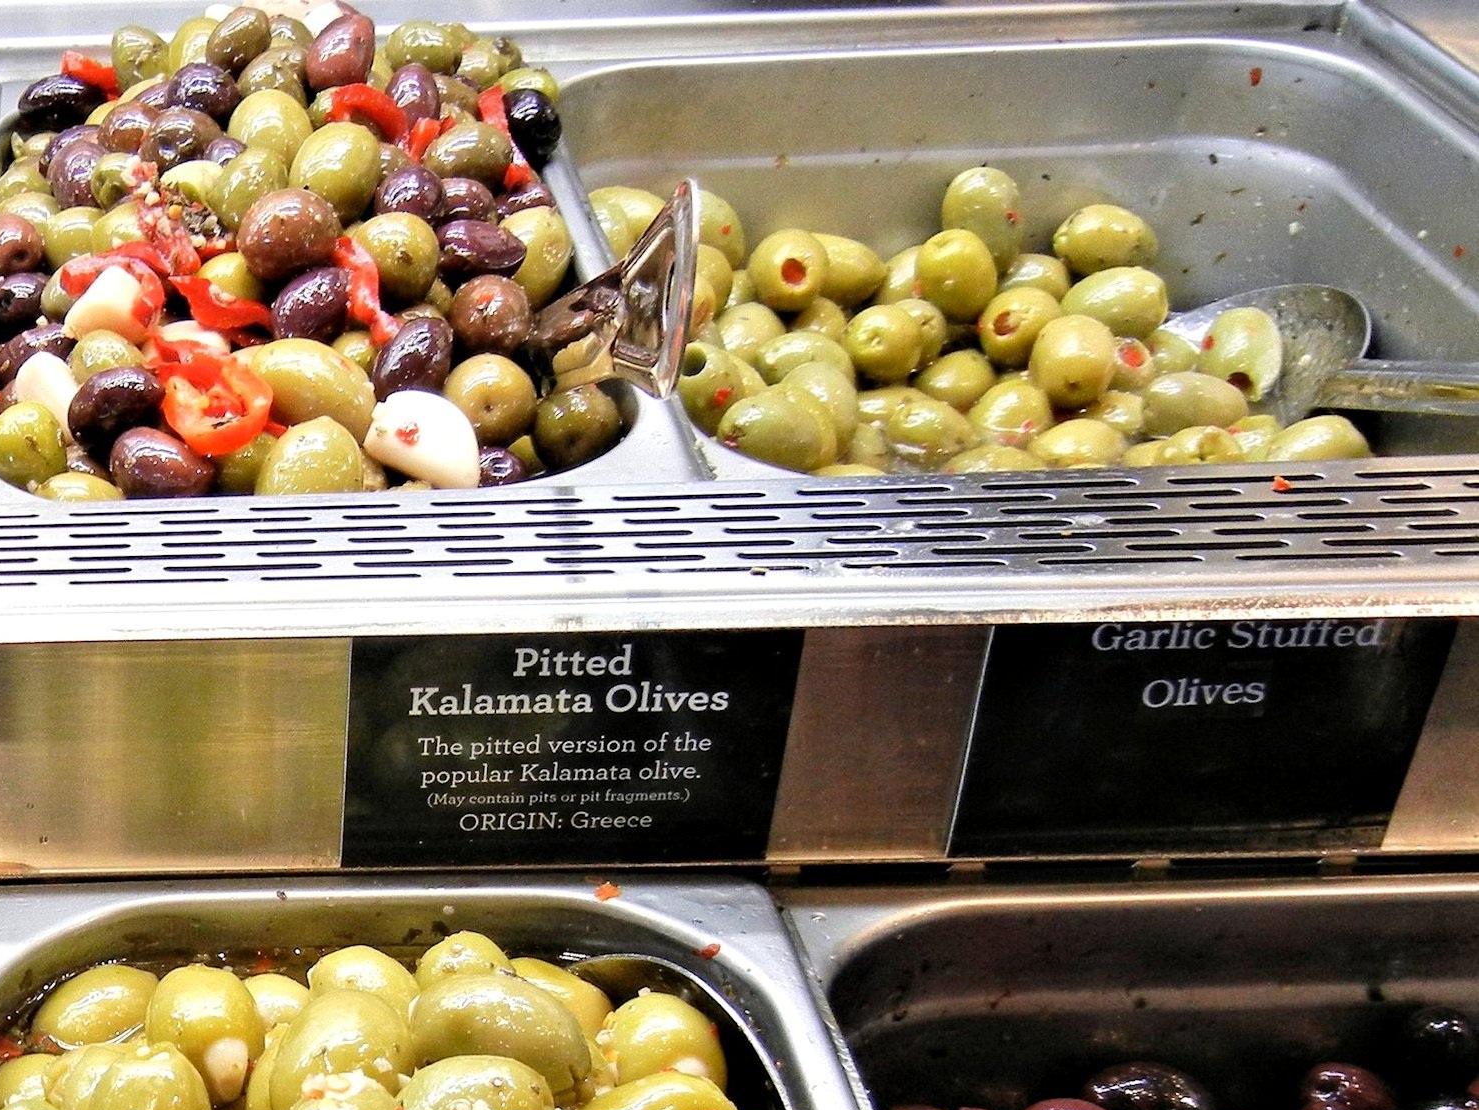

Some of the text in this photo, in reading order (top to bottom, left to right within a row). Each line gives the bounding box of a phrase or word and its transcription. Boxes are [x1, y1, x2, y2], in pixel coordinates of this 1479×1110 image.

[1091, 619, 1384, 652] Garlic Stuffed
[512, 644, 633, 677] Pitted
[408, 681, 729, 716] Kalamata Olives
[1142, 678, 1266, 709] Olives
[417, 732, 712, 760] The pitted version of the
[420, 761, 701, 788] popular Kalamata olive.
[427, 788, 691, 807] (May contain pits or pit fragments.)
[458, 811, 653, 832] ORIGIN: Greece
